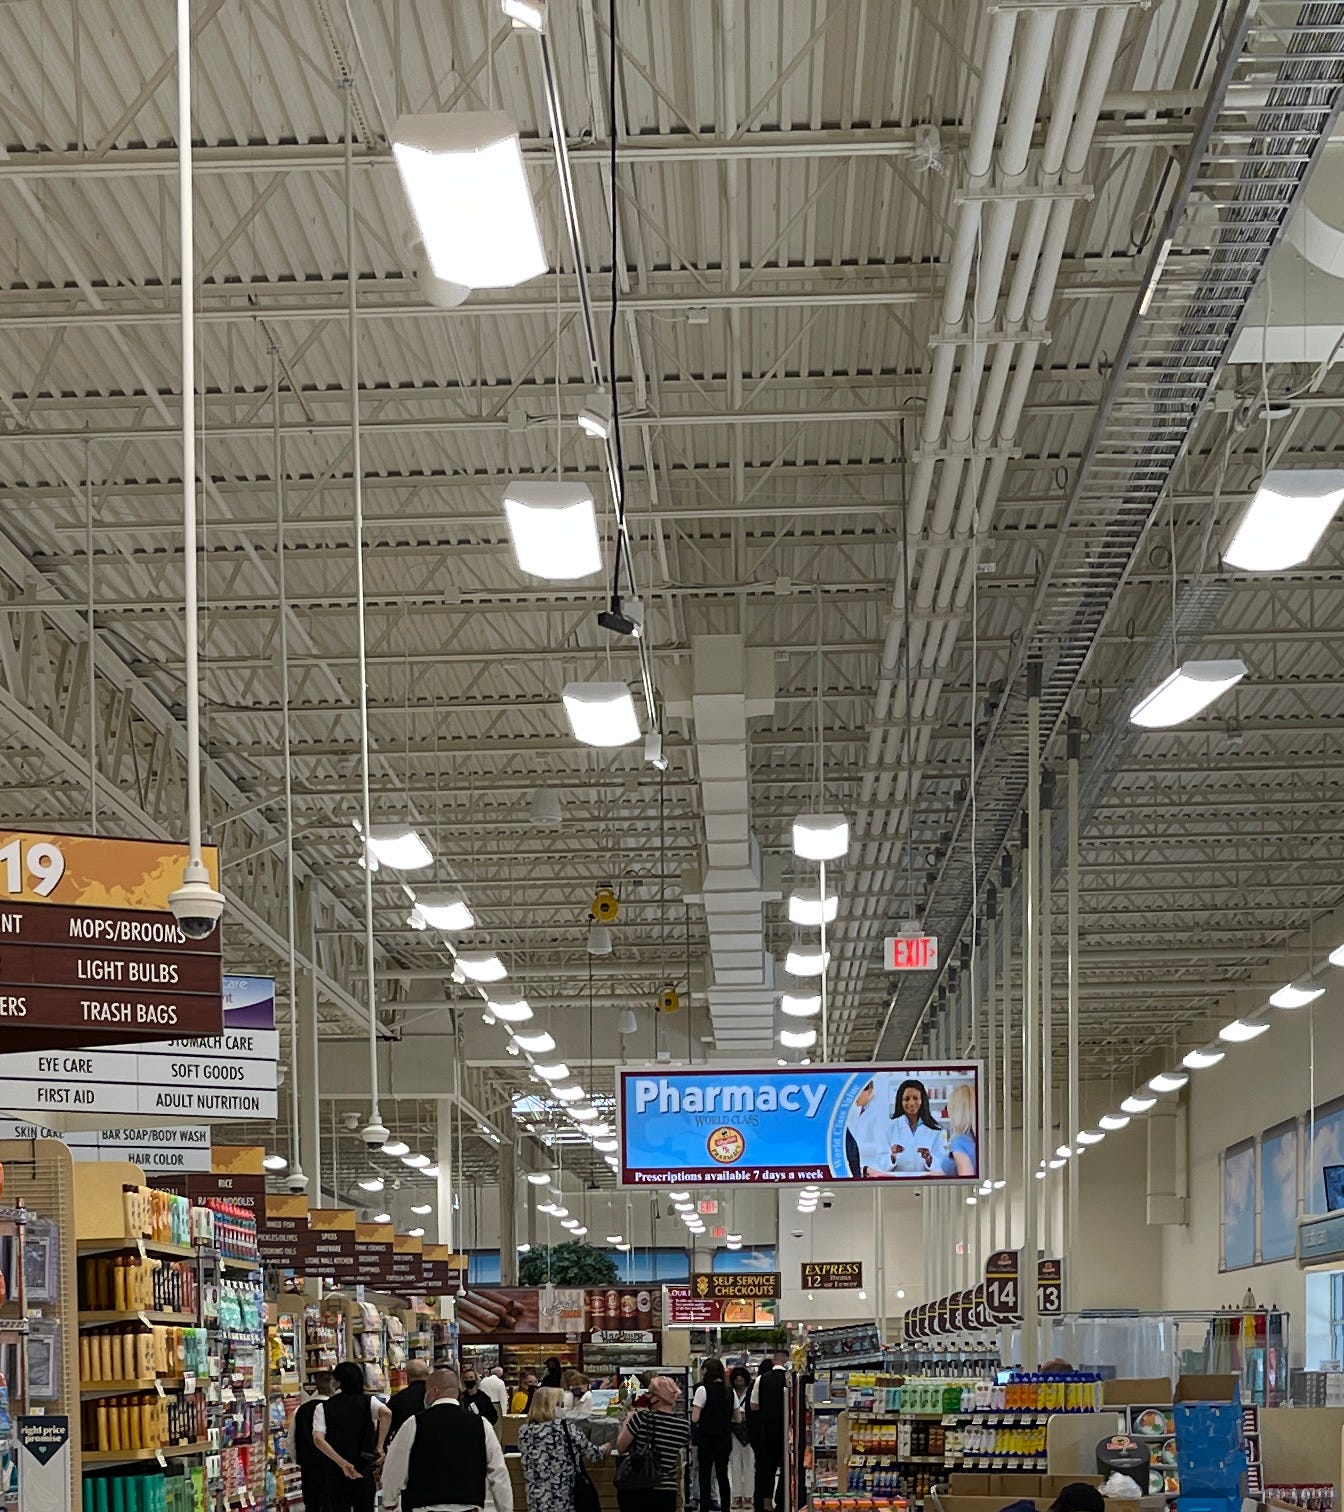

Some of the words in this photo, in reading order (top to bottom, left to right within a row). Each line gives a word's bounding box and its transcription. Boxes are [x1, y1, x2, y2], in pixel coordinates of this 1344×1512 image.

[68, 917, 187, 945] MOPS/BROOMS
[894, 938, 930, 968] EXIT
[77, 959, 125, 983] LIGHT
[128, 962, 179, 985] BULBS
[81, 1001, 131, 1023] TRASH
[136, 1003, 178, 1025] BAGS
[225, 1035, 254, 1051] CARE
[38, 1057, 60, 1074] EYE
[63, 1058, 93, 1075] CARE
[171, 1062, 199, 1079] SOFT
[203, 1064, 245, 1081] GOODS
[37, 1087, 71, 1104] FIRST
[74, 1089, 95, 1105] AID
[155, 1093, 193, 1109] ADULT
[197, 1094, 260, 1111] NUTRITION
[635, 1079, 828, 1119] Pharmacy
[14, 1125, 38, 1139] SKIN
[102, 1128, 120, 1140] BAR
[123, 1129, 177, 1142] SOAP/BODY
[180, 1130, 207, 1143] WASH
[128, 1153, 151, 1165] HAIR
[153, 1153, 185, 1166] COLOR
[634, 1171, 703, 1184] Prescriptions
[704, 1170, 751, 1182] available
[753, 1170, 760, 1181] 7
[762, 1170, 786, 1183] days
[796, 1169, 824, 1180] week
[805, 1263, 859, 1275] EXPRESS
[713, 1276, 735, 1286] SELF
[736, 1275, 776, 1285] SERVICE
[806, 1275, 822, 1288] 12
[714, 1286, 775, 1296] CHECKOUTS
[987, 1281, 1016, 1307] 14
[1036, 1286, 1059, 1311] 13
